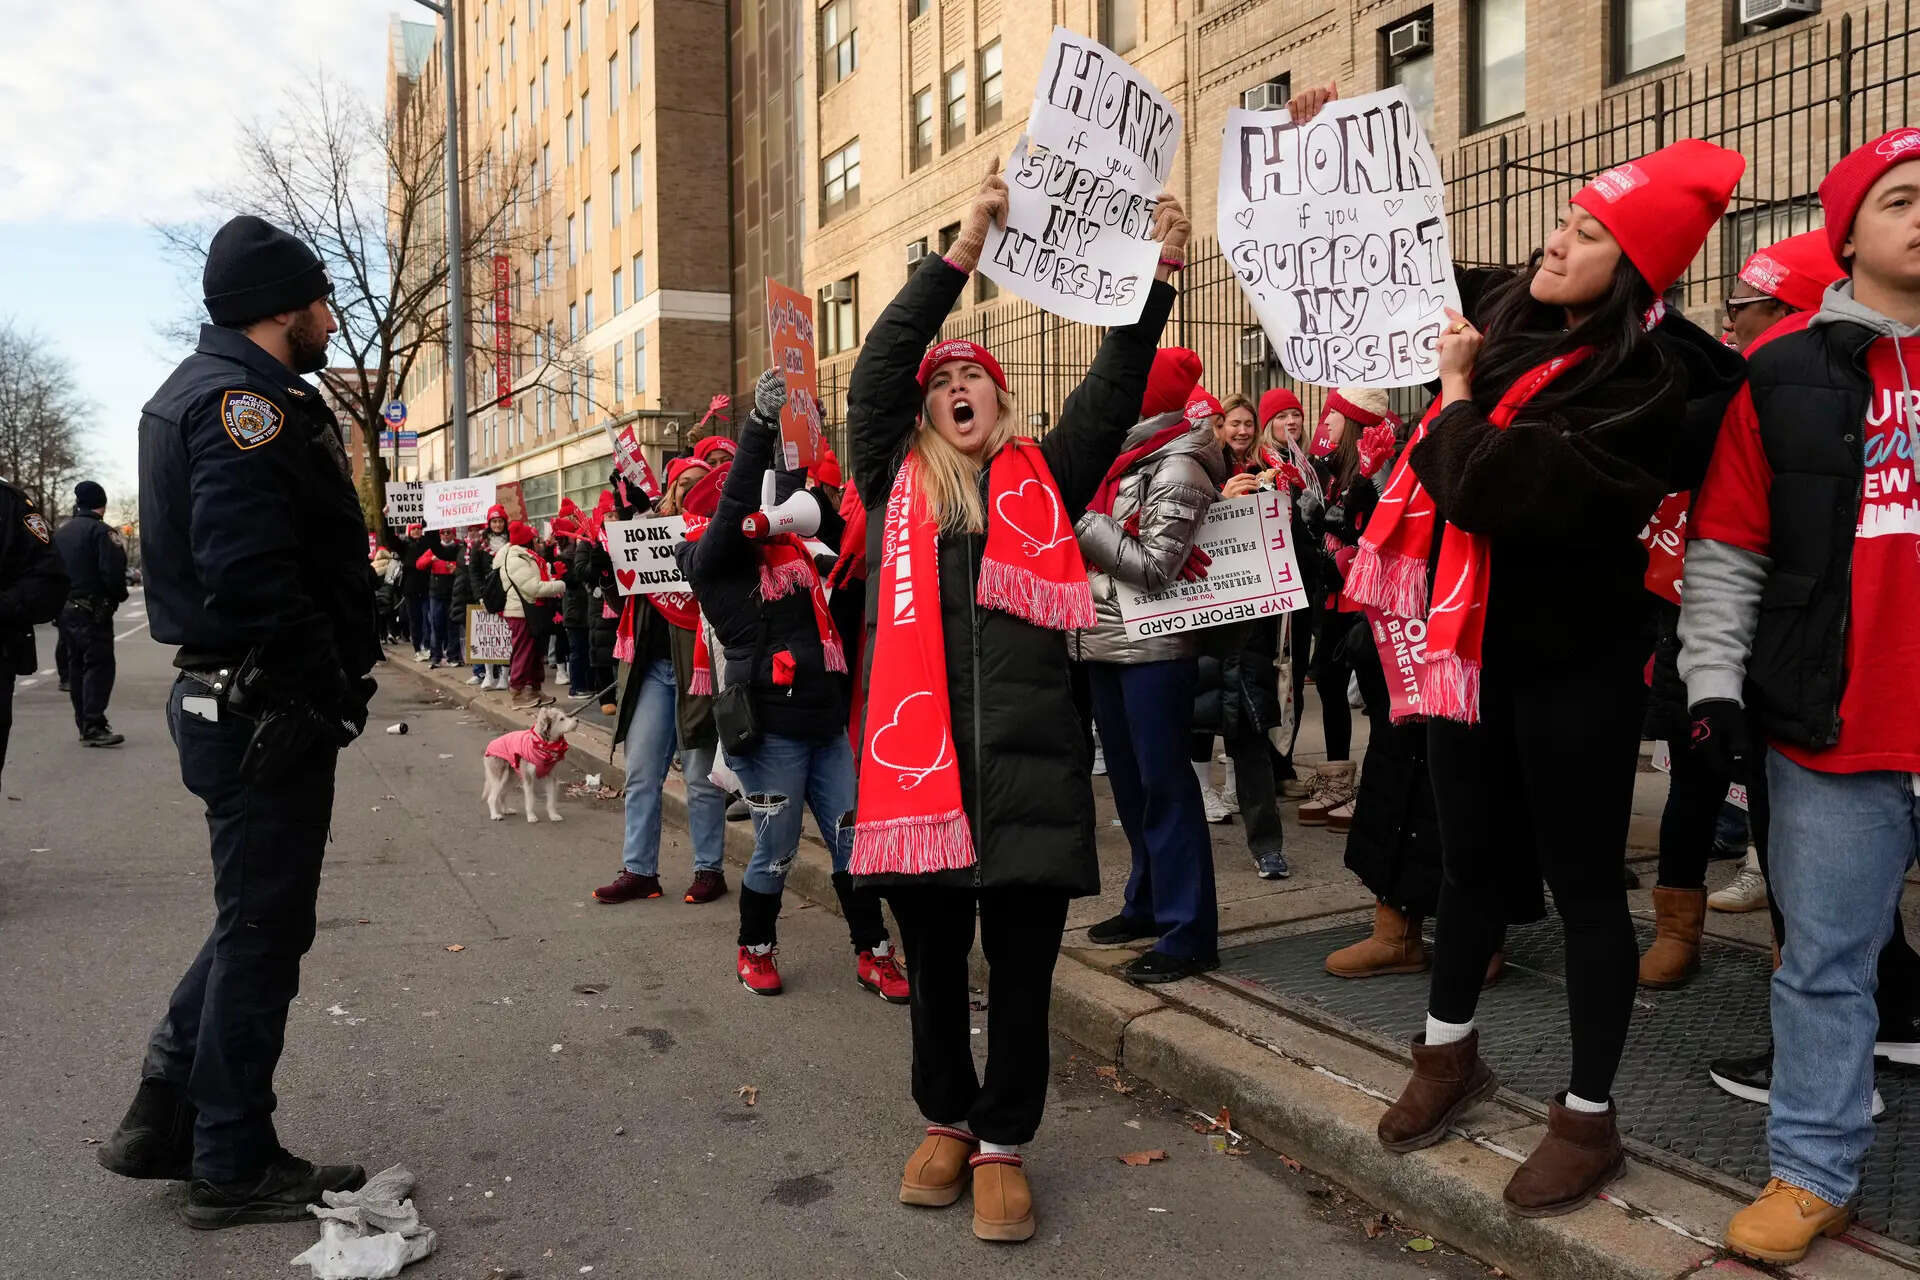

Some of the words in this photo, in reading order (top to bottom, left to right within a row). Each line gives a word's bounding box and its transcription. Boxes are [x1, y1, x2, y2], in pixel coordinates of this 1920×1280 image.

[1049, 42, 1174, 184] HONK
[1067, 127, 1088, 155] if
[1098, 156, 1136, 182] you
[1240, 100, 1431, 202] HONK
[1015, 144, 1160, 241] SUPPORT
[1042, 205, 1100, 257] NY
[1299, 203, 1311, 229] if
[1324, 207, 1359, 241] you
[1232, 216, 1446, 291] SUPPORT
[993, 227, 1138, 306] NURSES
[1291, 286, 1369, 335] NY
[229, 400, 278, 421] DEPARTMENT
[242, 395, 271, 410] POLICE
[225, 412, 235, 426] CITY
[231, 427, 239, 437] OF
[250, 435, 264, 444] NEW
[264, 425, 277, 437] YORK
[406, 481, 423, 490] THE
[1865, 468, 1910, 498] EW
[390, 494, 422, 502] TORTU
[439, 489, 480, 502] OUTSIDE
[398, 504, 423, 513] NURS
[886, 493, 901, 529] York
[1208, 507, 1254, 524] FAILING
[1265, 498, 1279, 518] F
[389, 516, 424, 525] DEPART
[778, 517, 793, 526] PYLE
[624, 526, 672, 543] HONK
[1271, 529, 1285, 550] F
[624, 549, 639, 562] IF
[883, 529, 897, 568] New
[1208, 541, 1257, 558] FAILING
[1214, 575, 1262, 590] FAILING
[1278, 562, 1292, 583] F
[1134, 590, 1177, 605] NURSES
[1180, 583, 1211, 596] YOUR
[1201, 593, 1216, 601] You
[1191, 604, 1256, 626] REPORT
[1260, 596, 1294, 614] NYP
[1139, 616, 1186, 635] CARD
[1387, 615, 1420, 705] BENEFITS
